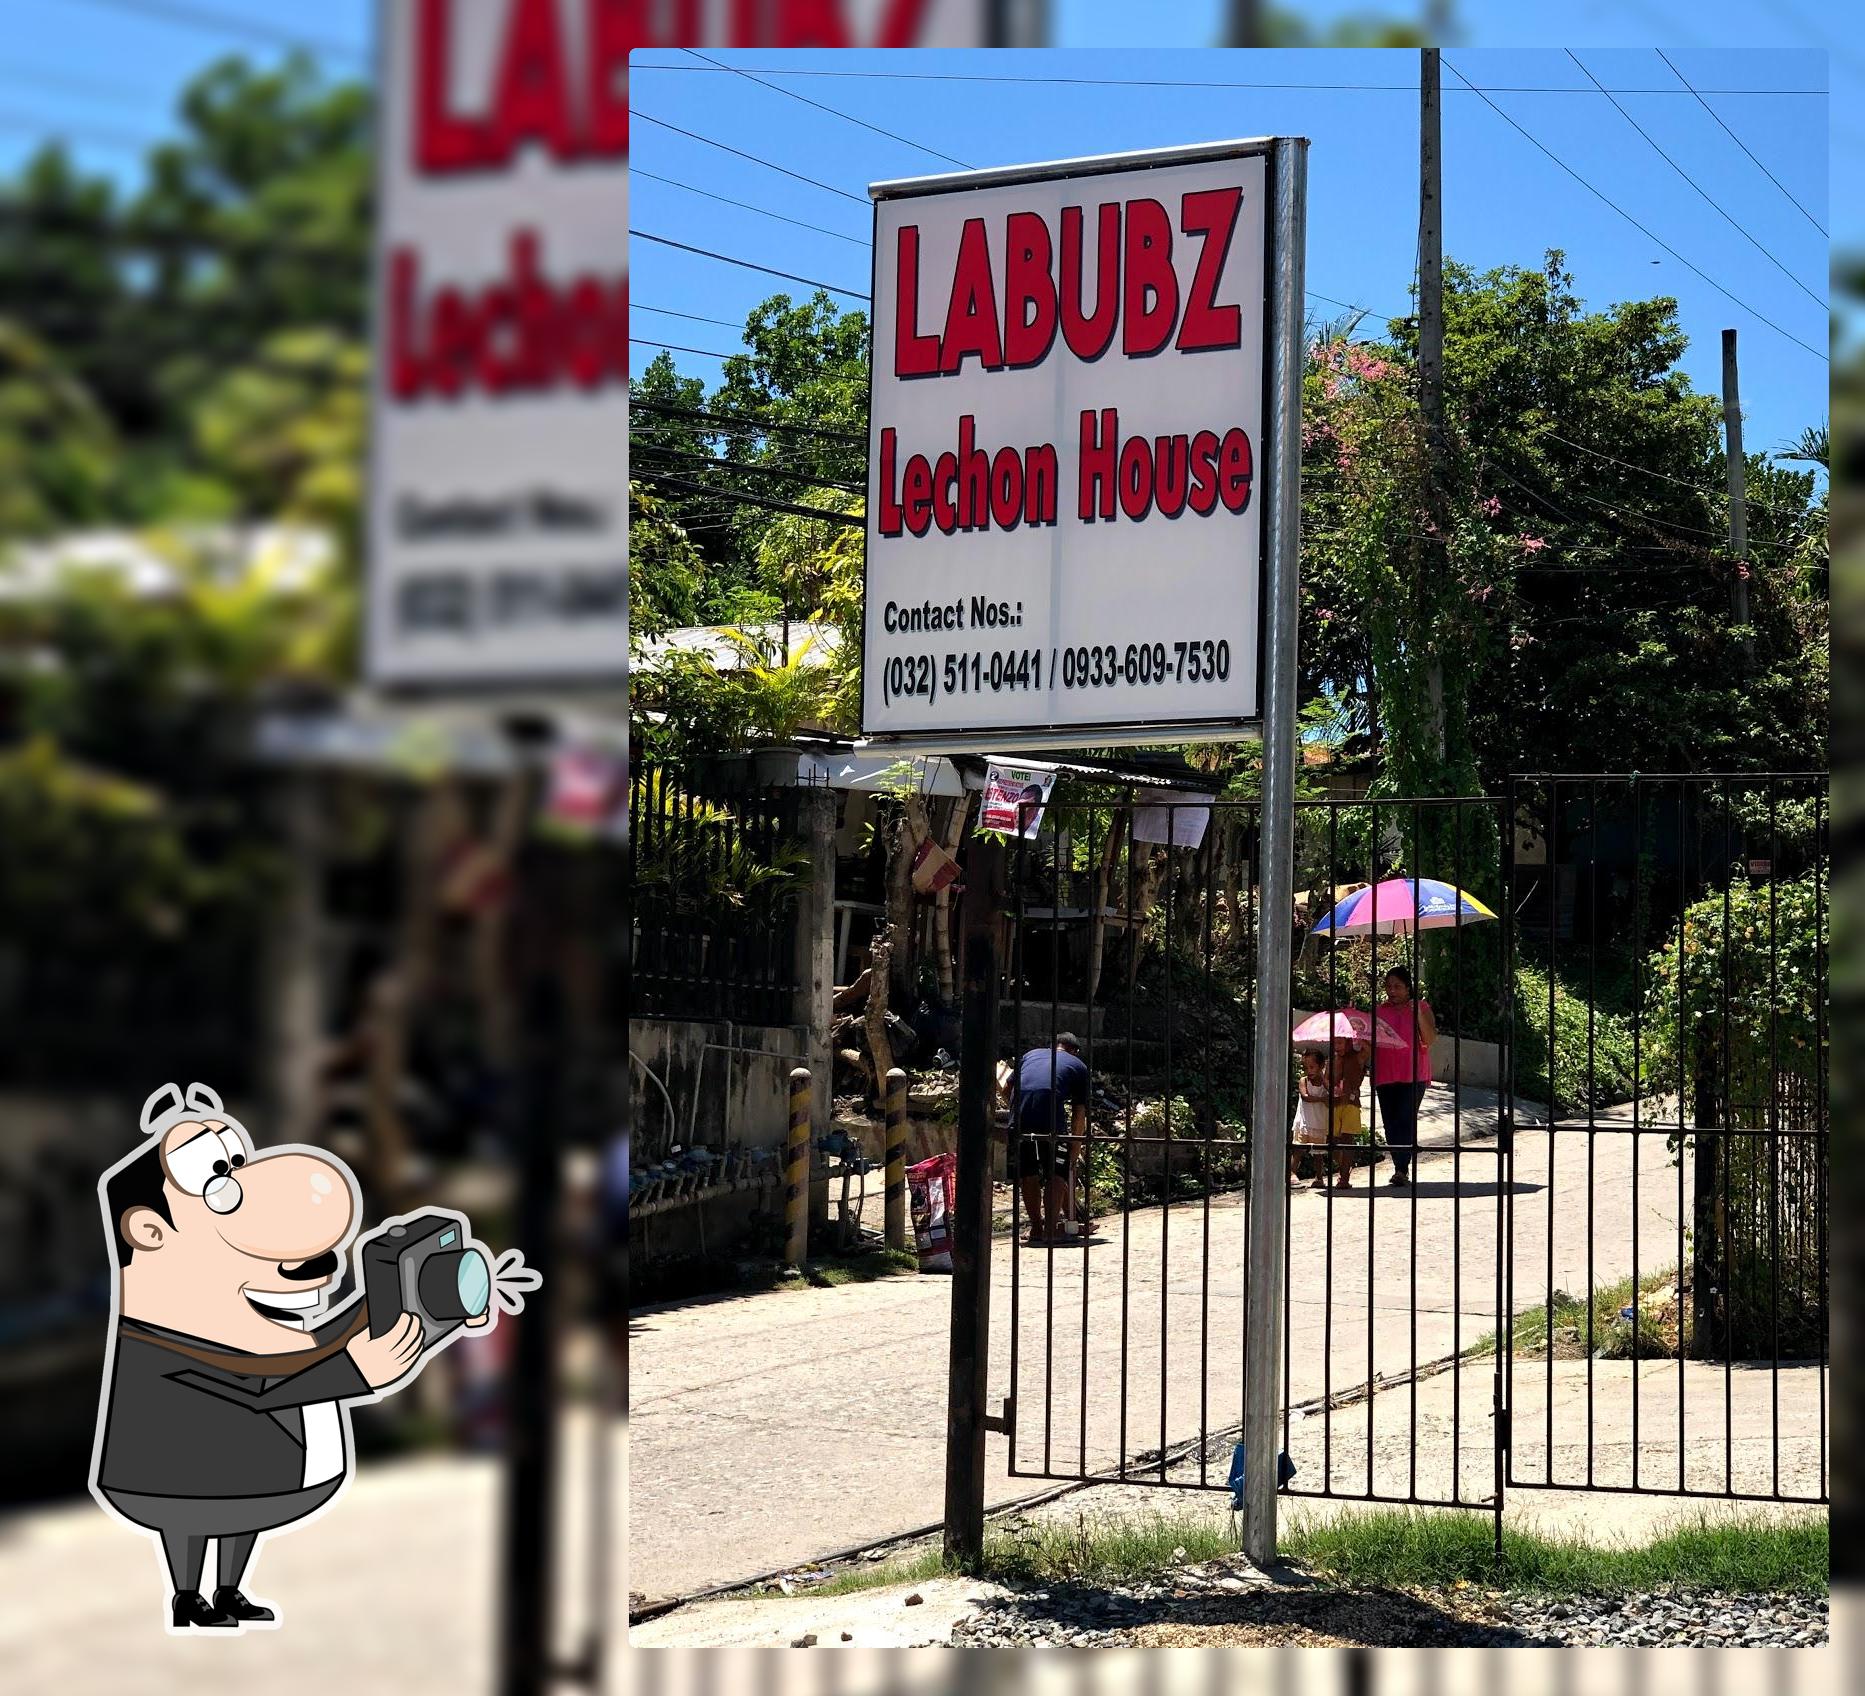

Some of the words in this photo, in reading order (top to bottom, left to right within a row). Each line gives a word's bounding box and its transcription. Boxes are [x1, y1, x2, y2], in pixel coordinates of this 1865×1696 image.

[894, 186, 1244, 379] LABUBZ
[878, 414, 1059, 539] Lechon
[1078, 407, 1254, 524] House
[884, 599, 964, 634] Contact
[970, 595, 1022, 629] Nos.:
[883, 654, 936, 707] (032)
[943, 648, 1042, 695] 511-0441
[1049, 647, 1057, 690] /
[1062, 639, 1231, 689] 0933-609-7530
